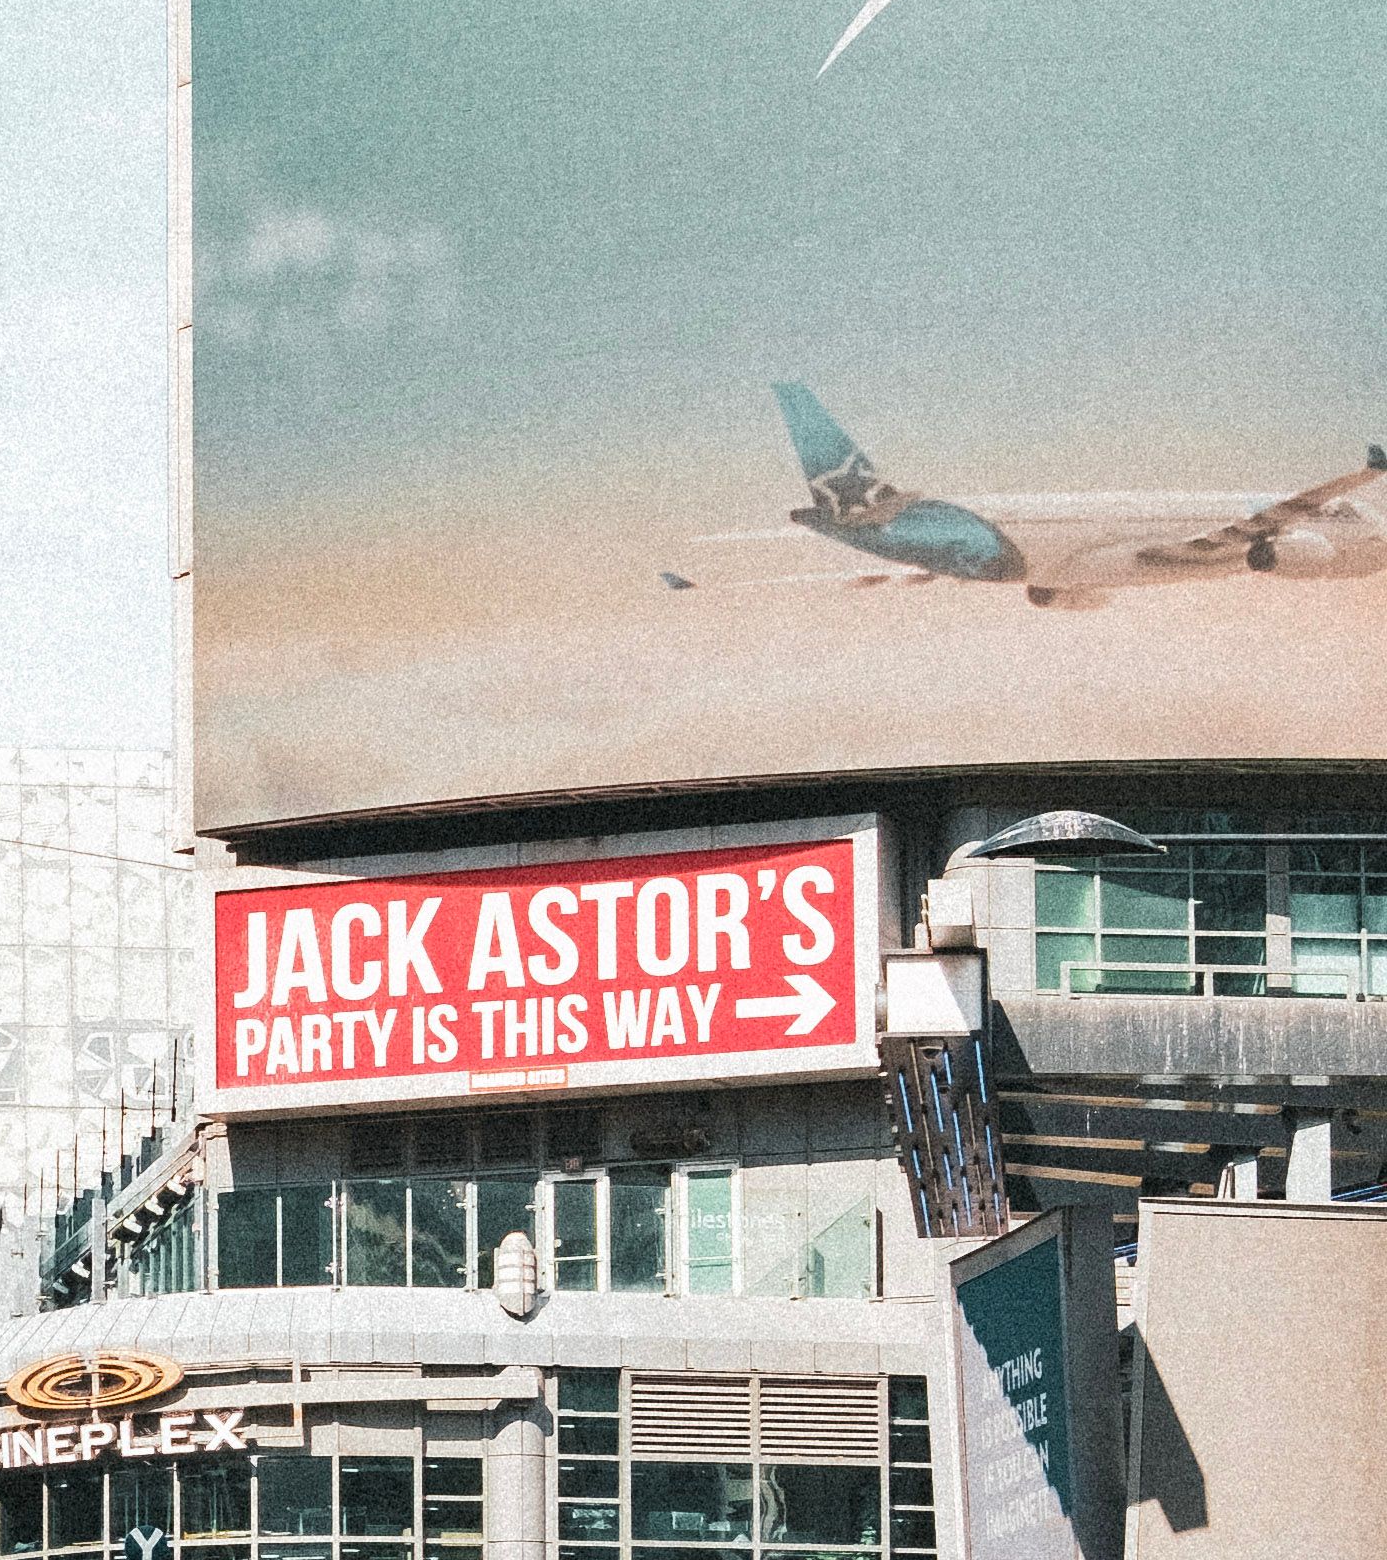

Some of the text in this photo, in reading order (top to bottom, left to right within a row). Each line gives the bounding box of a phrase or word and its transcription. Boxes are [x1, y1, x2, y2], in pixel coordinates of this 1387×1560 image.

[234, 865, 835, 1010] JACK ASTOR'S
[236, 983, 723, 1078] PARTY IS THIS WAY
[981, 1347, 1043, 1402] ANYTHING
[994, 1392, 1048, 1443] POSSIBLE
